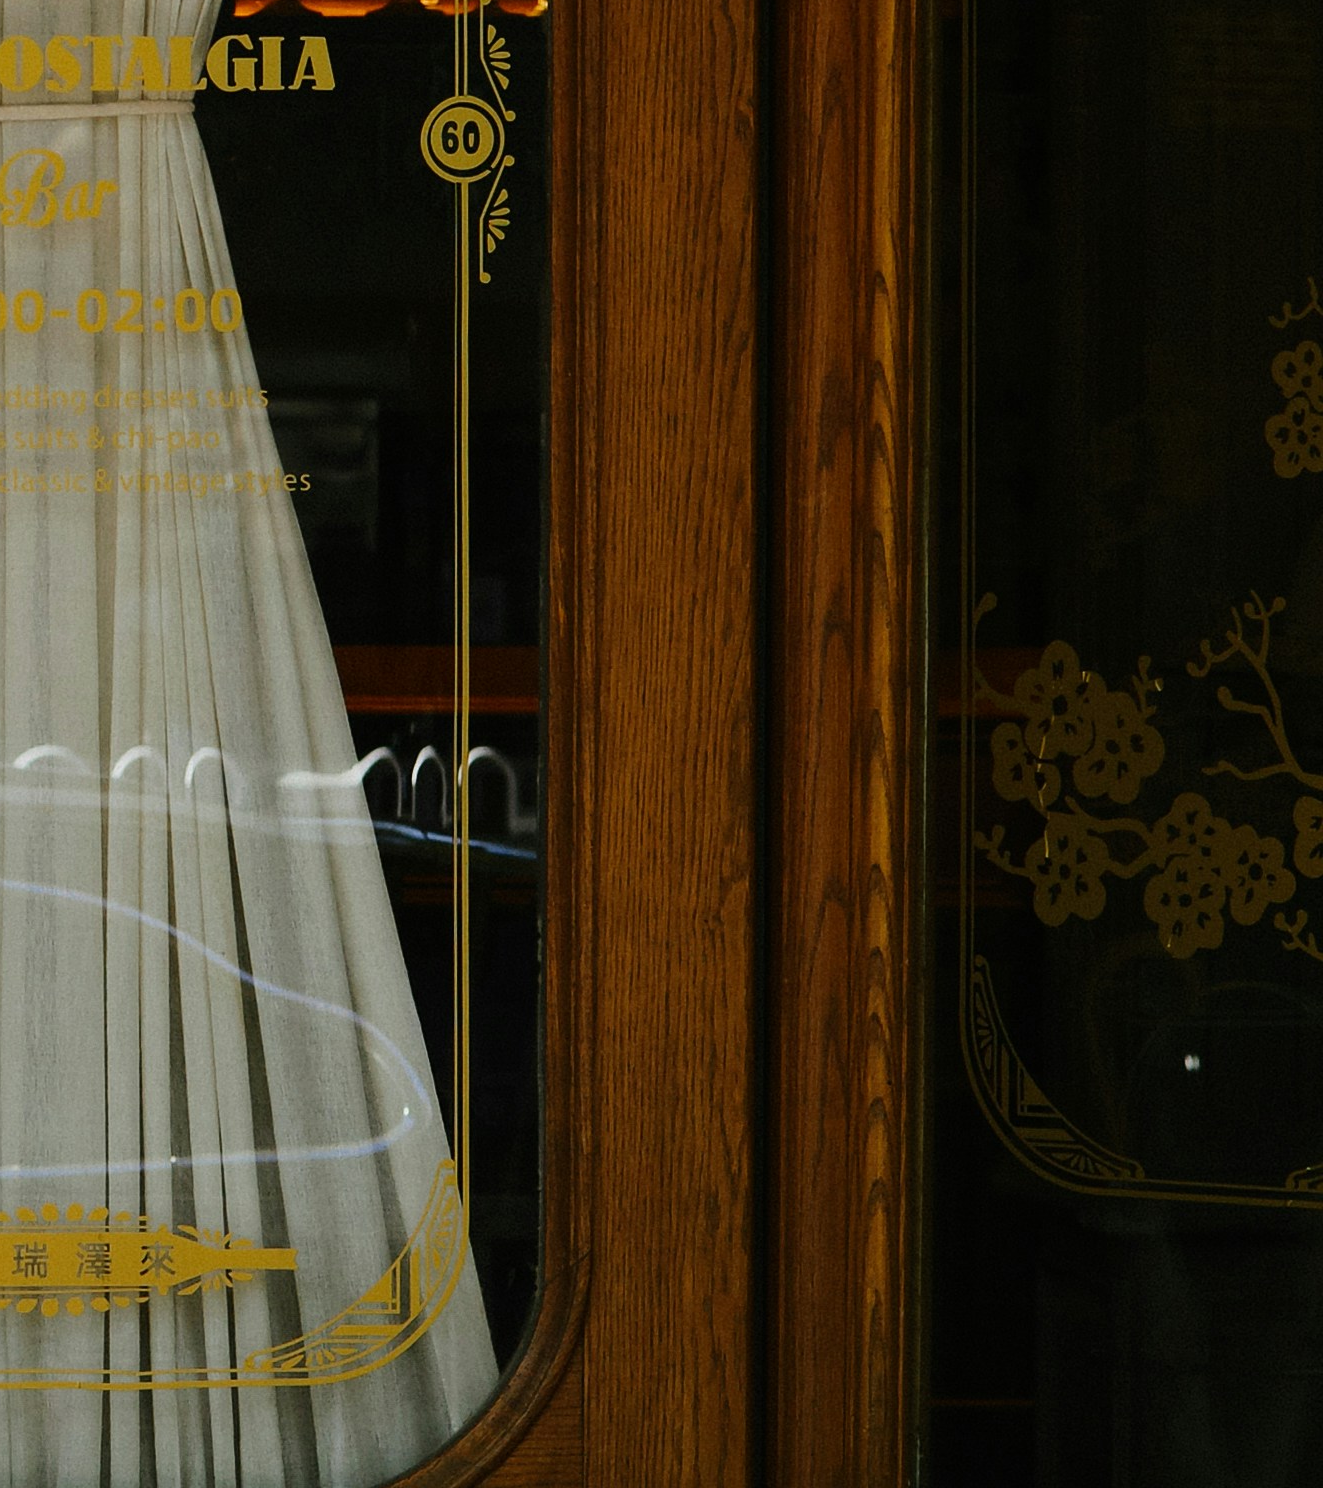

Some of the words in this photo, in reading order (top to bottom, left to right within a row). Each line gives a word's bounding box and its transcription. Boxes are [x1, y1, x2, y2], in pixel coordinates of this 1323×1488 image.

[441, 120, 481, 155] 60
[93, 385, 197, 410] dresses
[205, 386, 270, 410] suits
[13, 427, 80, 451] suits
[85, 428, 107, 451] &
[92, 470, 114, 495] &
[119, 469, 223, 500] vintage
[229, 470, 313, 500] styles
